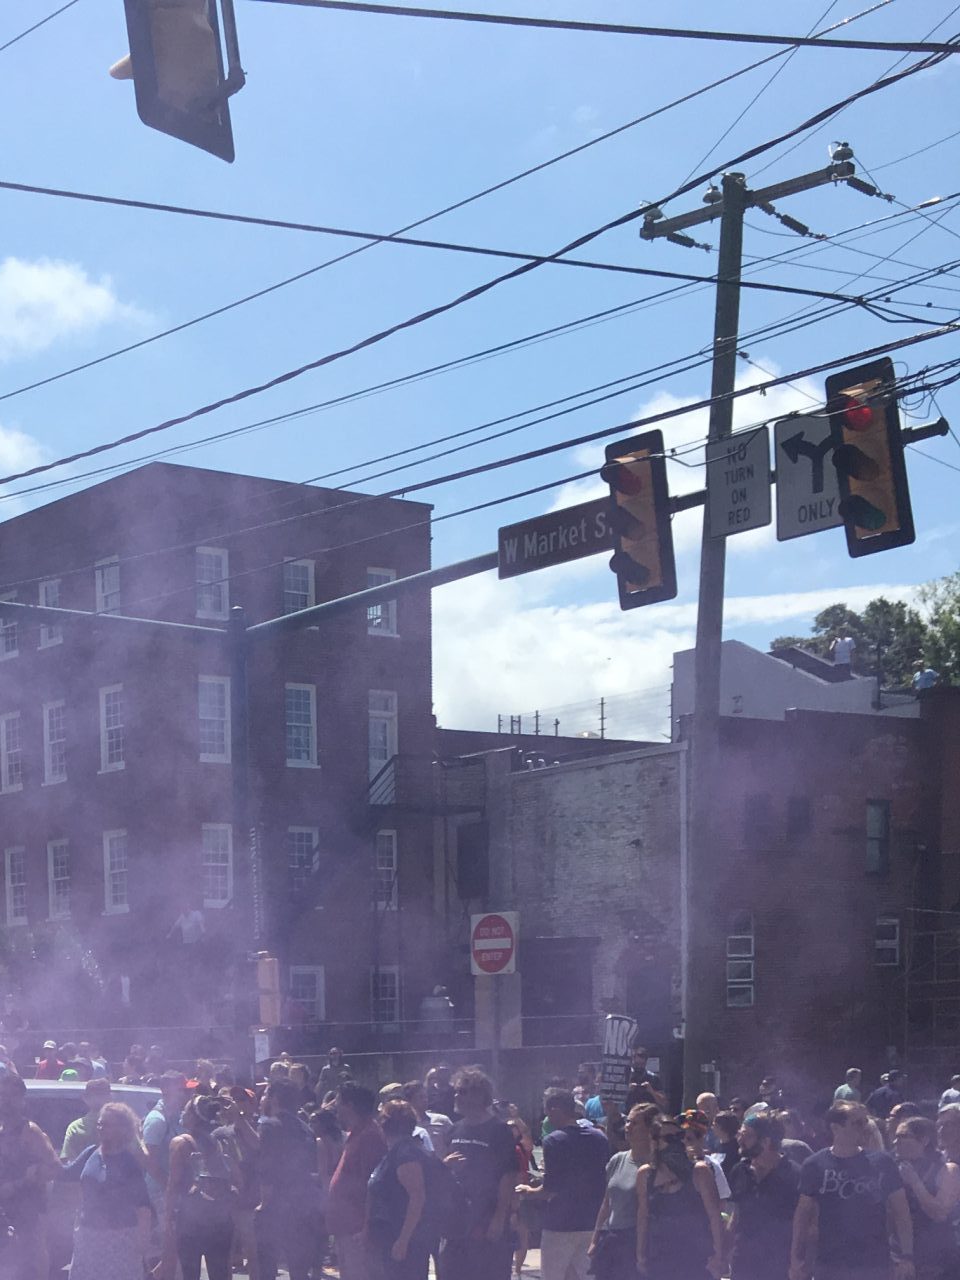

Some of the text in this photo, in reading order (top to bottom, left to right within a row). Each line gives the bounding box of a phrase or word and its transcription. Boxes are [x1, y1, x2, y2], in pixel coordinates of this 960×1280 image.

[726, 442, 747, 465] NO
[724, 464, 754, 486] TURN
[731, 487, 747, 504] ON
[728, 506, 751, 525] RED
[797, 497, 836, 523] ONLY
[503, 536, 519, 564] W
[523, 517, 588, 559] Market
[480, 951, 504, 962] ENTER
